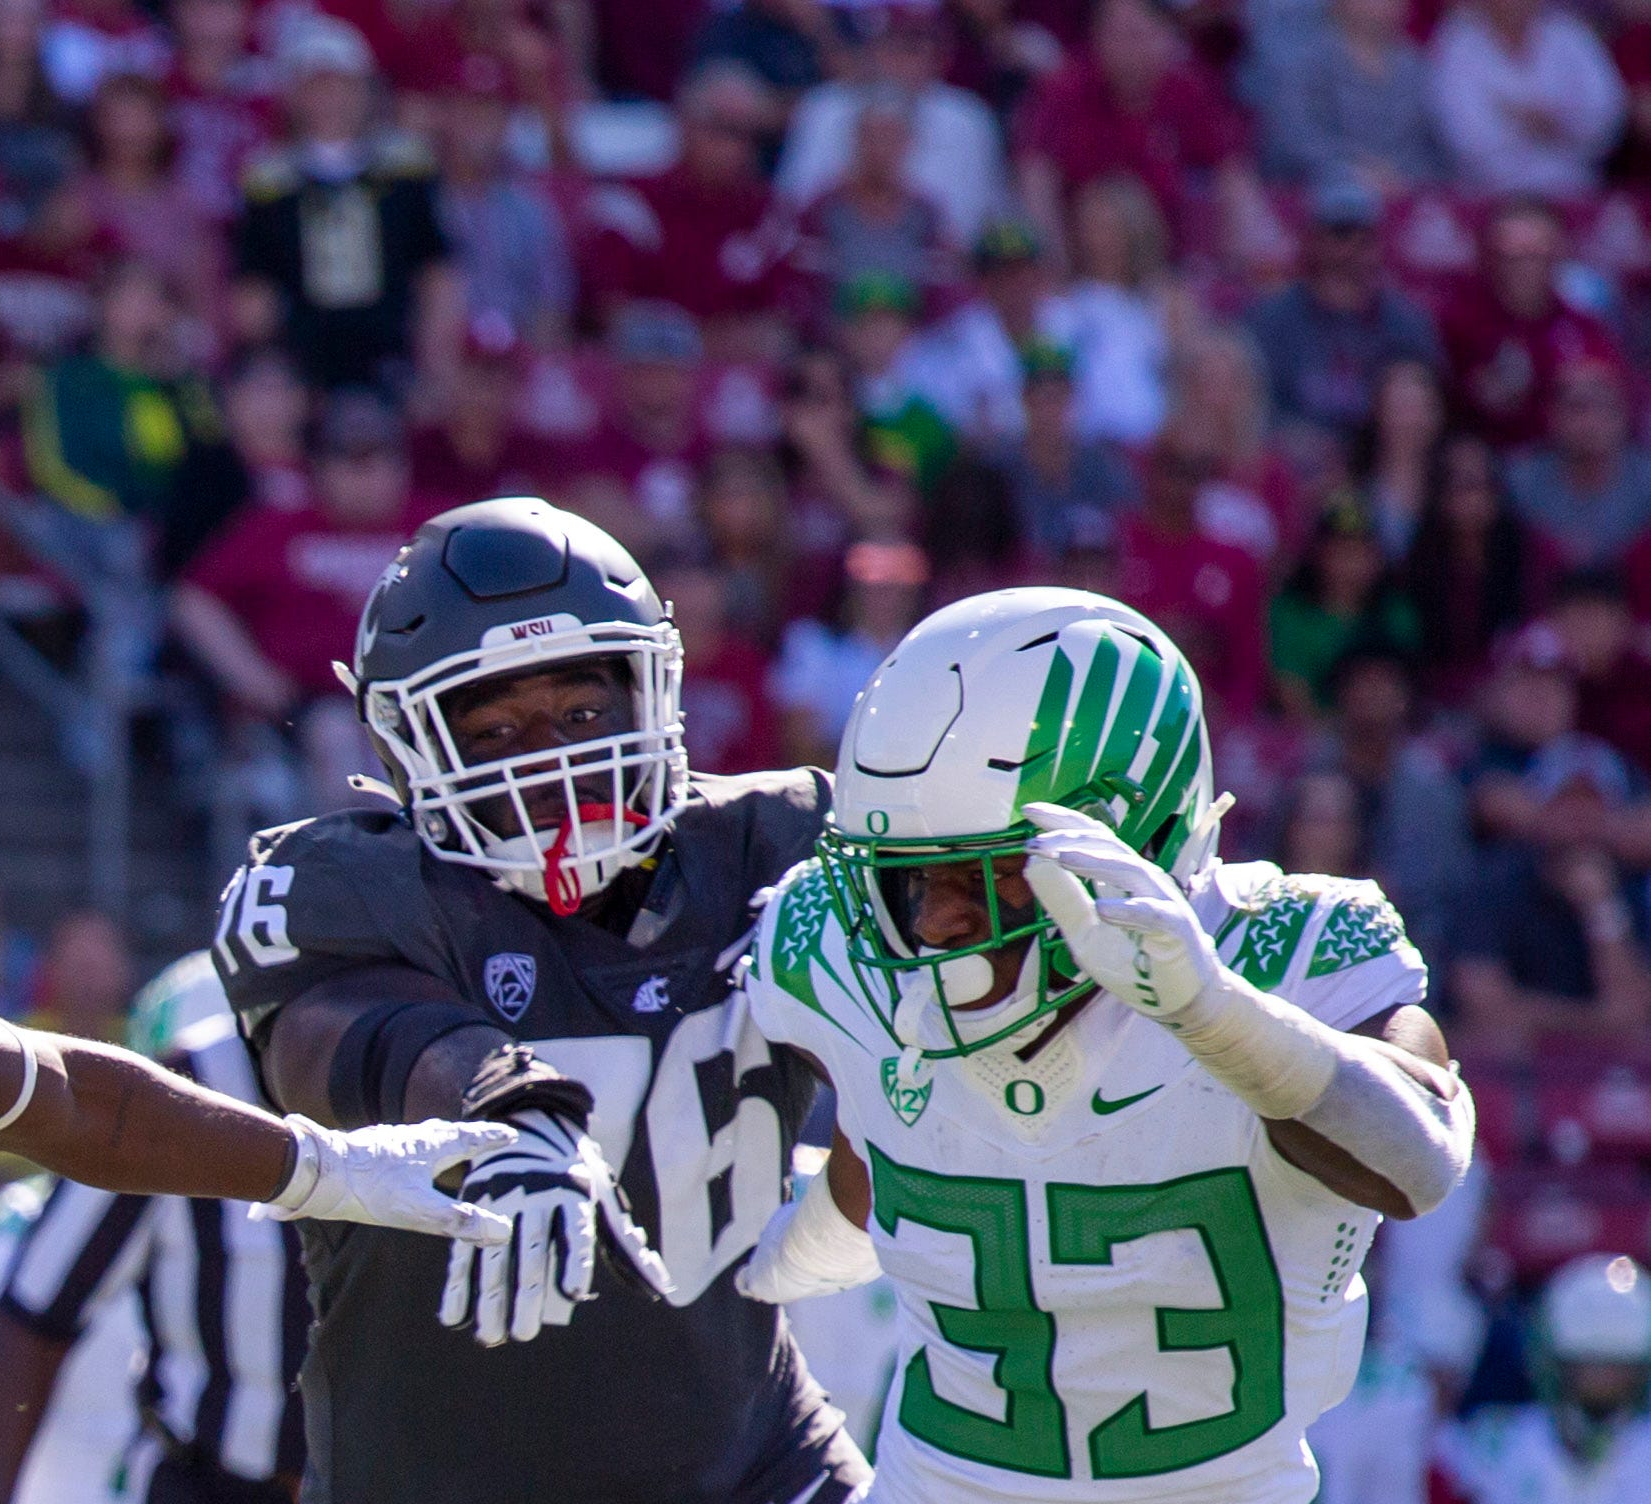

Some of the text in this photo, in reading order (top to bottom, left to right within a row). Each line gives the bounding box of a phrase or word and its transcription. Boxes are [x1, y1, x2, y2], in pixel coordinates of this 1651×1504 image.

[510, 619, 554, 641] WSU
[1005, 1079, 1045, 1116] O
[867, 1140, 1287, 1480] 33
